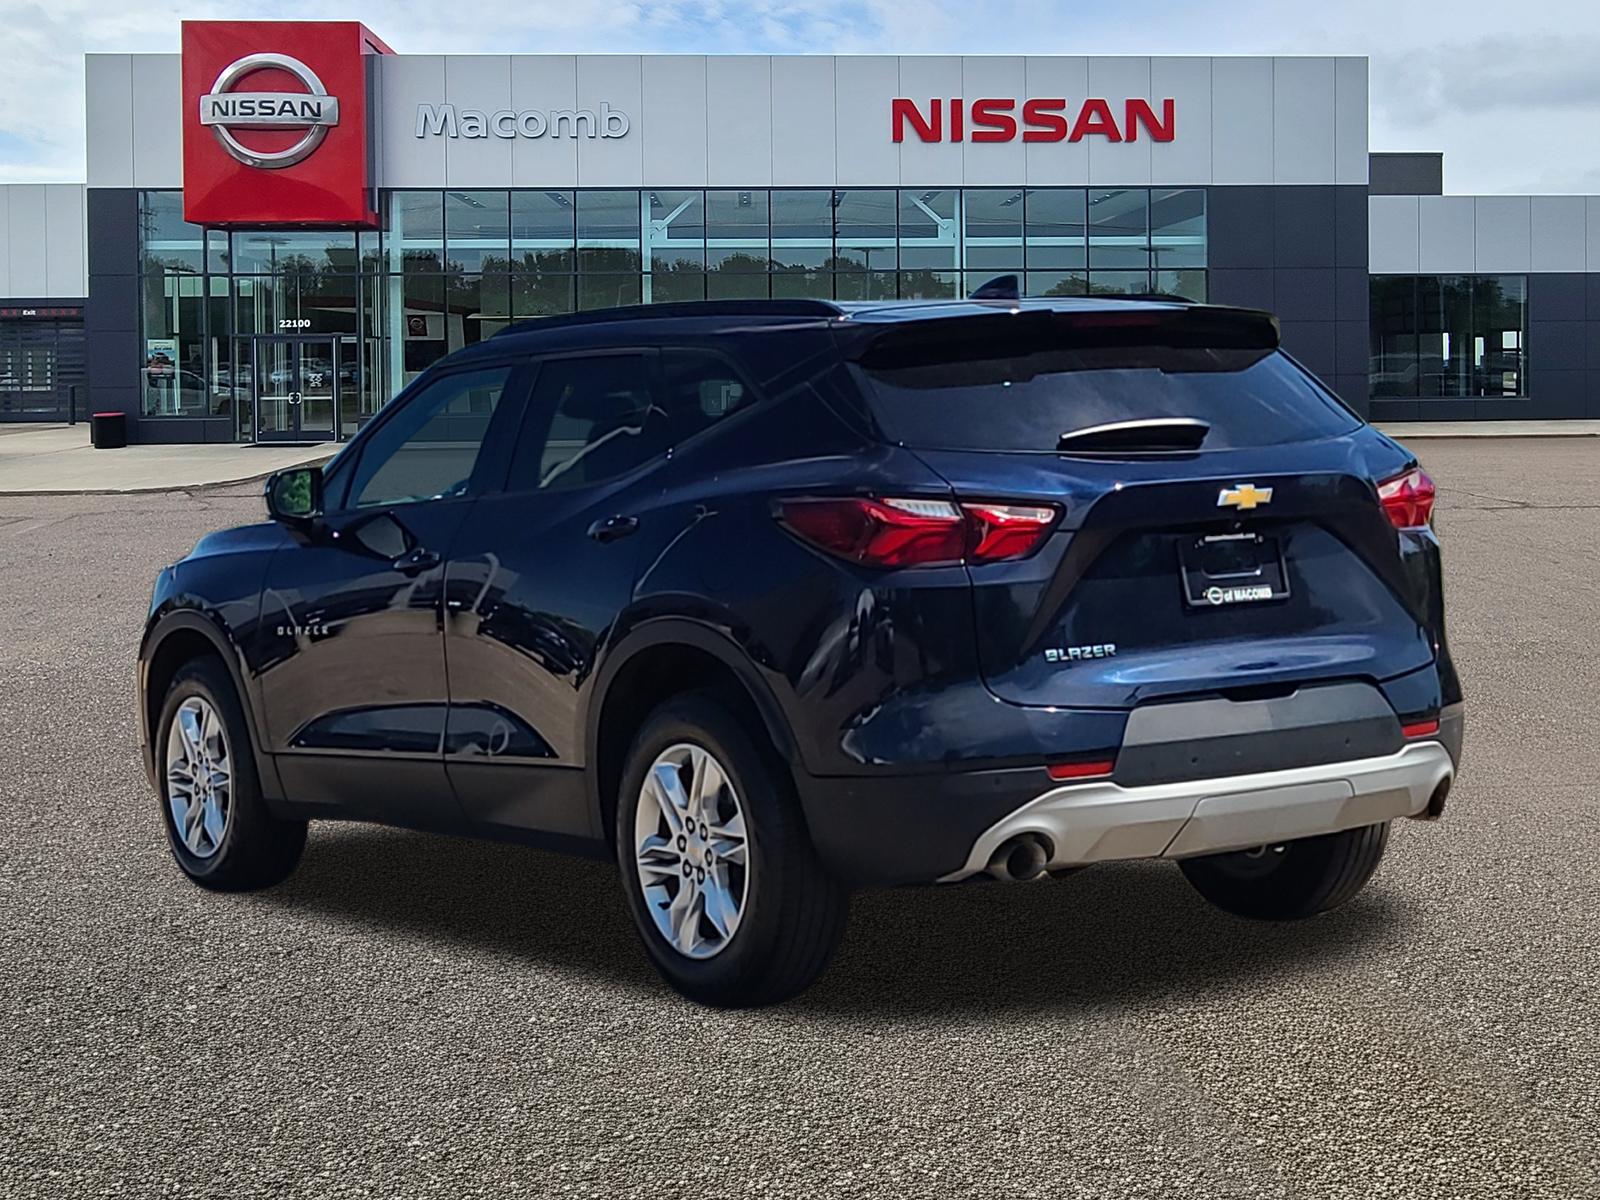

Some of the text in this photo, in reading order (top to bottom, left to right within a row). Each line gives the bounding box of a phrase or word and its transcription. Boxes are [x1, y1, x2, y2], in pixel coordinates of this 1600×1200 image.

[211, 100, 322, 118] NISSAN
[415, 101, 630, 139] Macomb
[892, 98, 1175, 143] NISSAN
[279, 319, 311, 328] 22100
[1234, 587, 1273, 600] MACOMB
[277, 625, 329, 636] BLAZER
[1044, 643, 1117, 662] BLAZER
